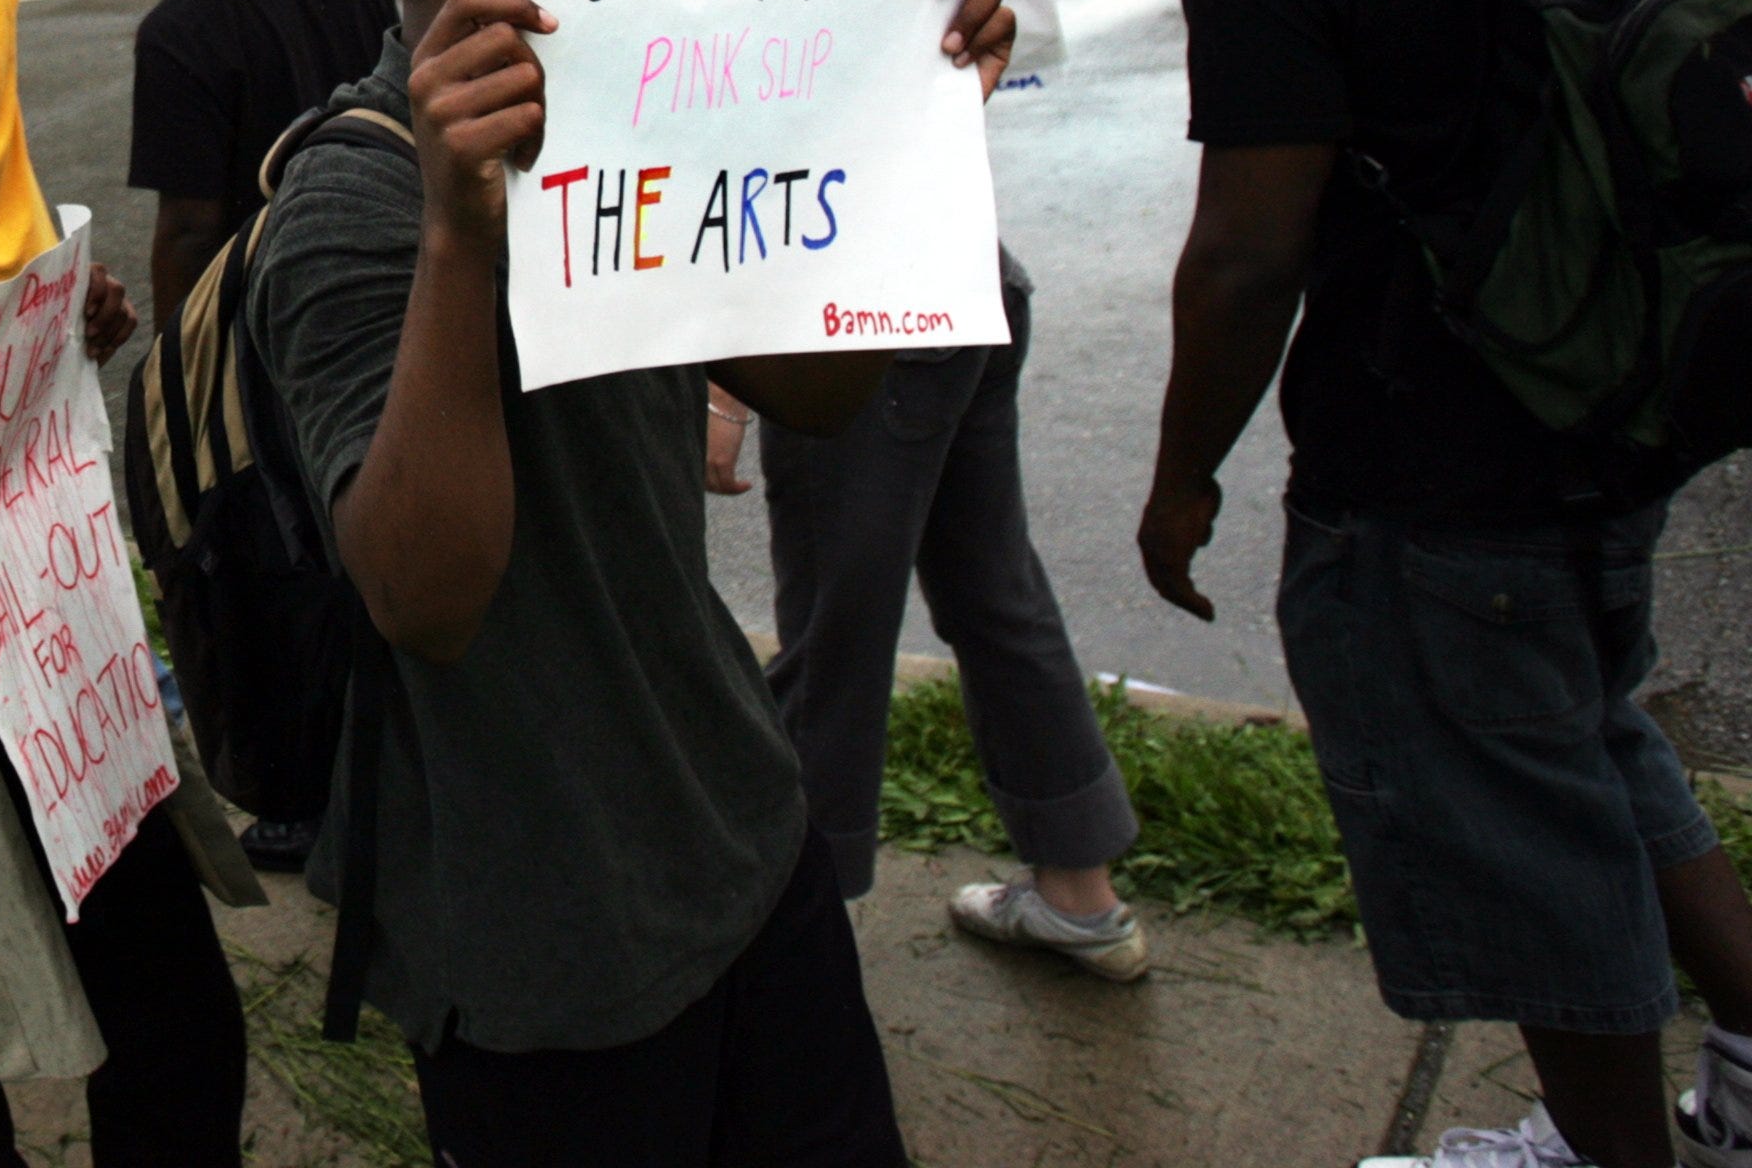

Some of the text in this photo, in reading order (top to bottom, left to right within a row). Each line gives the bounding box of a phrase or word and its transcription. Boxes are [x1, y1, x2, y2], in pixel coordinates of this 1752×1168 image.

[633, 28, 834, 127] PINK SLIP
[542, 165, 846, 288] THE ARTS
[823, 302, 954, 337] Bamn.com
[33, 624, 83, 689] FOR
[20, 641, 158, 813] EDUCATIO
